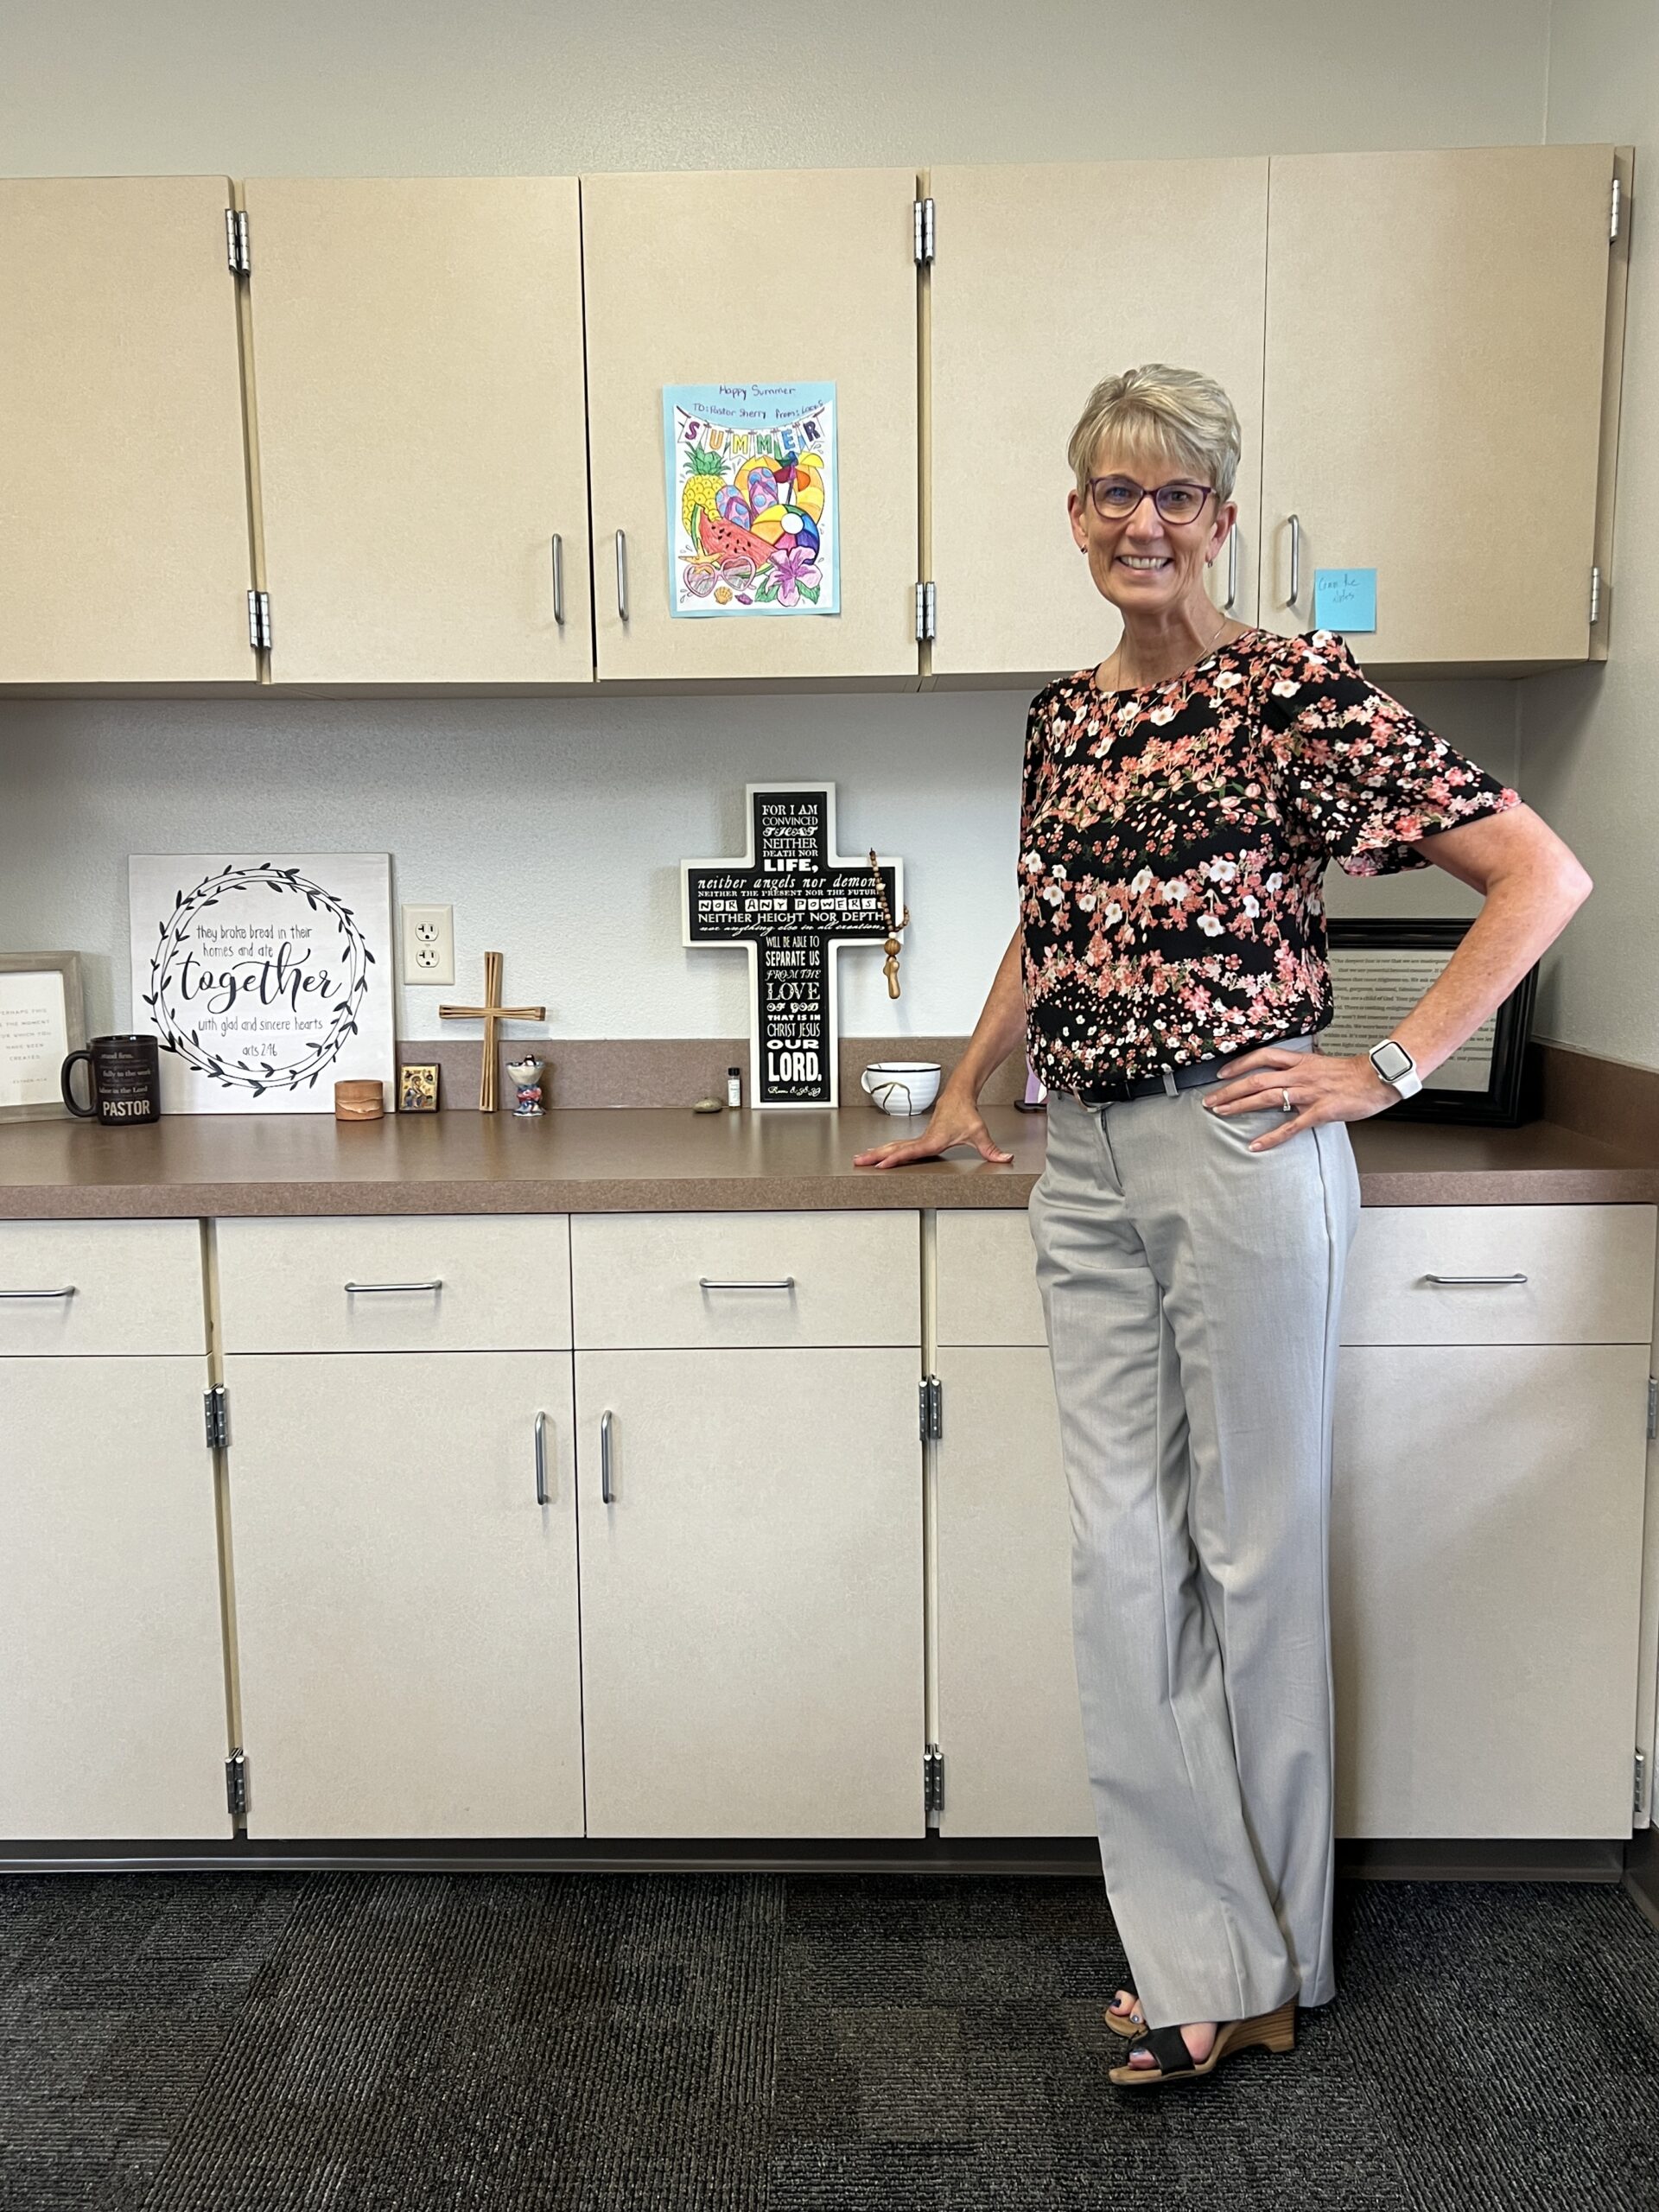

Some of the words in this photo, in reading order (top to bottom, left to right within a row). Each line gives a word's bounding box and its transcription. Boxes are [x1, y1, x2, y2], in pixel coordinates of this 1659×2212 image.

[719, 385, 747, 400] Happy
[752, 385, 796, 396] Summer
[740, 409, 766, 419] Sherry
[684, 421, 820, 451] SUMMER
[762, 804, 786, 815] FOR
[790, 804, 795, 815] I
[798, 804, 817, 815] AM
[762, 817, 818, 826] CONVINCED
[762, 826, 818, 836] THAT
[763, 838, 818, 849] NEITHER
[764, 859, 818, 873] LIFE,
[697, 874, 747, 889] neither
[753, 874, 796, 891] angels
[803, 878, 826, 887] nor
[833, 874, 881, 888] demon
[699, 899, 738, 911] NOR
[746, 899, 786, 911] ANY
[698, 913, 752, 923] NEITHER
[753, 912, 805, 925] HEIGHT
[810, 912, 836, 922] NOR
[842, 912, 884, 921] DEPTH
[196, 925, 217, 943] they
[220, 925, 246, 939] broke
[250, 925, 274, 939] bread
[277, 928, 286, 939] in
[289, 925, 312, 939] their
[724, 925, 775, 937] anything
[817, 920, 839, 930] all
[766, 936, 780, 948] WILL
[783, 936, 791, 948] BE
[792, 936, 807, 947] ABLE
[810, 935, 820, 947] TO
[203, 943, 233, 957] homes
[238, 942, 253, 957] and
[257, 943, 273, 957] ate
[766, 950, 806, 966] SEPARATE
[809, 950, 820, 966] US
[175, 942, 342, 1014] together
[765, 969, 799, 982] FROM
[800, 969, 822, 979] THE
[766, 982, 821, 1001] LOVE
[766, 1002, 786, 1012] OF
[790, 1002, 819, 1014] GOD
[199, 1017, 218, 1031] with
[221, 1016, 238, 1037] glad
[241, 1017, 257, 1031] and
[259, 1019, 290, 1031] sincere
[295, 1017, 323, 1030] hearts
[767, 1023, 796, 1038] CHRIST
[798, 1022, 821, 1039] JESUS
[243, 1045, 259, 1056] acts
[766, 1039, 819, 1050] OUR
[768, 1052, 822, 1082] LORD.
[103, 1100, 150, 1116] PASTOR
